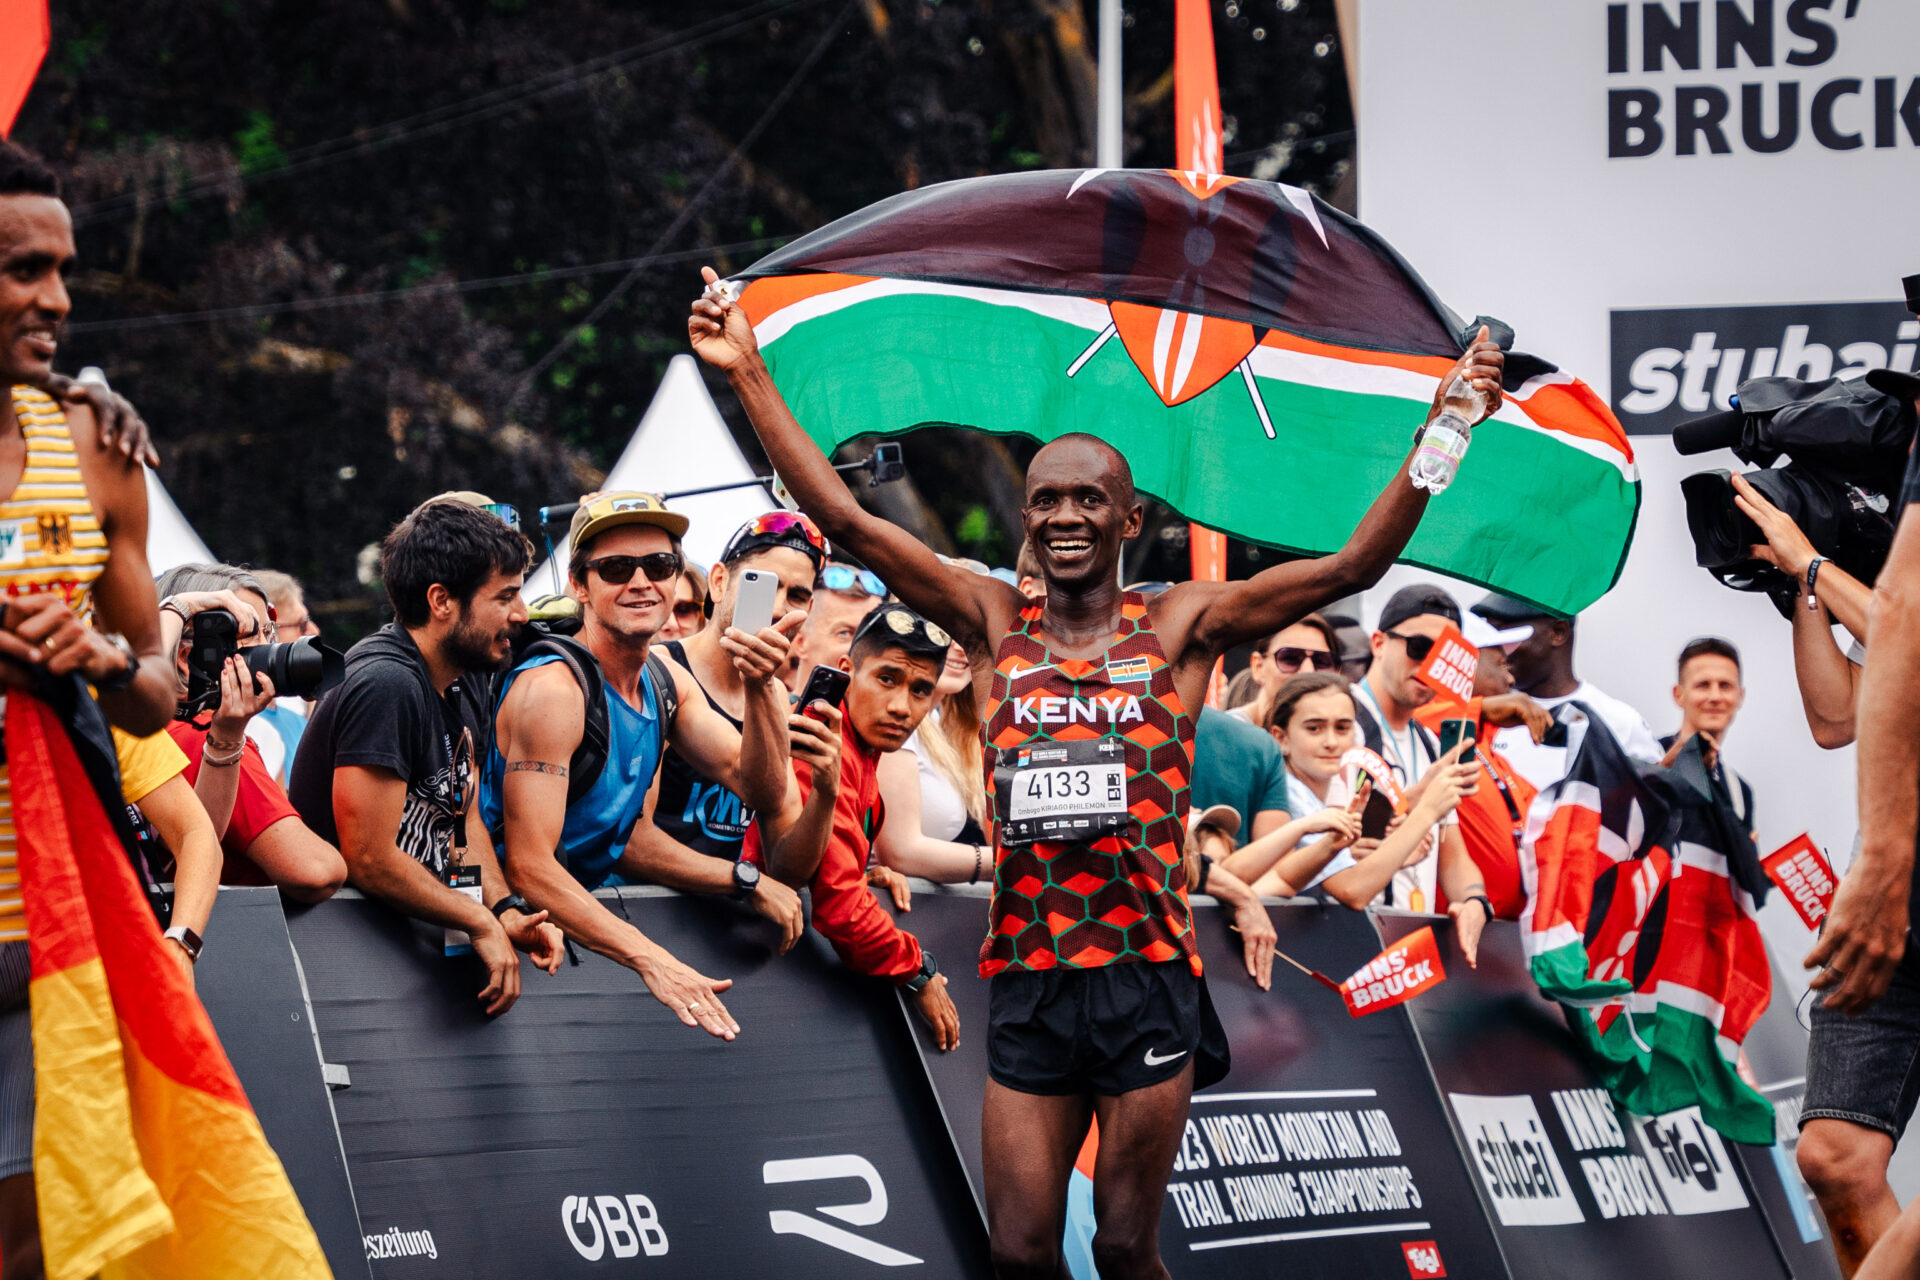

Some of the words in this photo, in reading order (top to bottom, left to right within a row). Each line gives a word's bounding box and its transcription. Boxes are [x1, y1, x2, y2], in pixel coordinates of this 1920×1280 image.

[1608, 76, 1920, 158] BRUCK
[1013, 694, 1144, 724] KENYA
[1027, 770, 1091, 799] 4133
[1776, 859, 1827, 922] BRUCK
[1345, 946, 1408, 991] INNS'
[1351, 958, 1434, 1009] BRUCK
[1200, 1114, 1280, 1167] WORLD
[1269, 1110, 1368, 1162] MOUNTAIN
[1357, 1109, 1402, 1157] AND
[1476, 1119, 1561, 1199] stubai
[1167, 1179, 1234, 1229] TRAIL
[1223, 1172, 1306, 1223] RUNNING
[1299, 1165, 1423, 1216] CHAMPIONSHIPS
[561, 1194, 669, 1261] ÖBB
